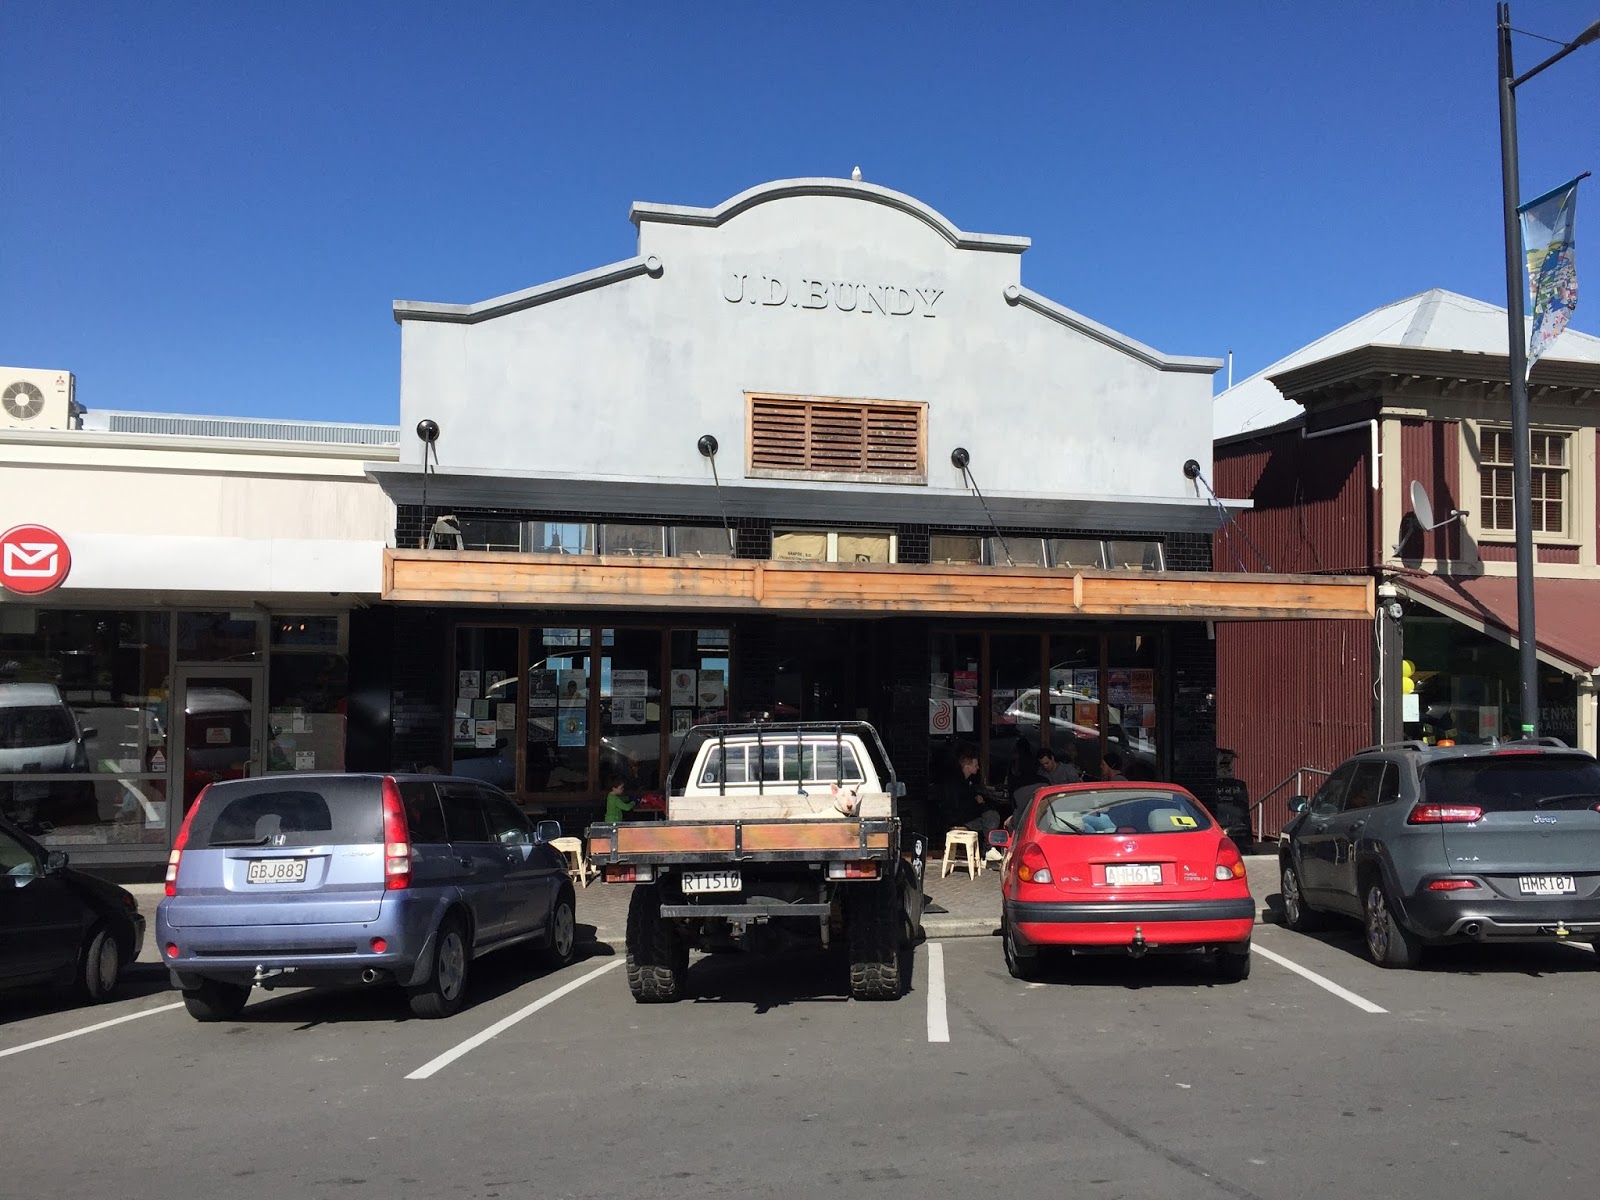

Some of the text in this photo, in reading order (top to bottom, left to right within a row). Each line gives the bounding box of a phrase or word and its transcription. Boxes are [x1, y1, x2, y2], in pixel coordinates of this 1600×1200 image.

[1538, 706, 1577, 720] ENRY
[1538, 720, 1577, 731] RADING
[1532, 815, 1557, 824] Jeep
[250, 863, 304, 879] GBJ883
[1107, 866, 1161, 883] AHH615
[684, 873, 740, 890] RT1510
[1521, 876, 1574, 891] HMR107
